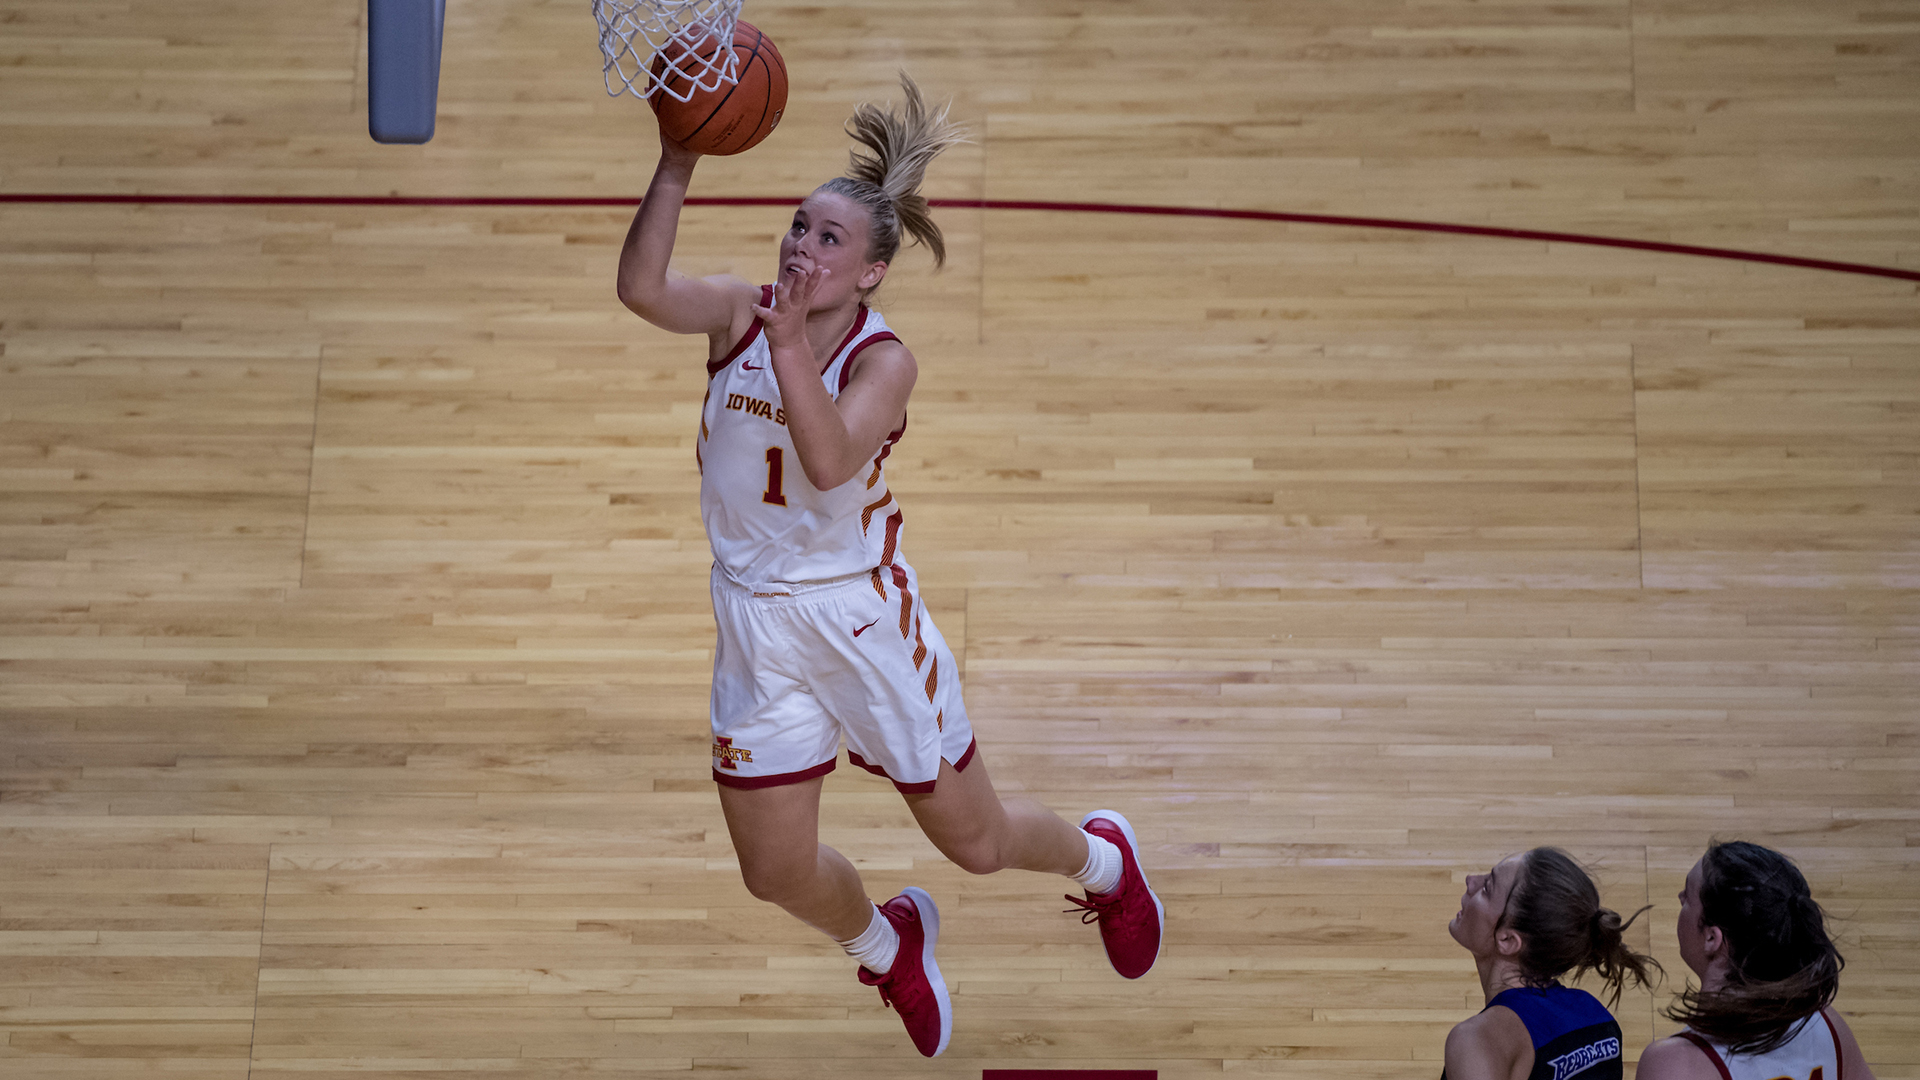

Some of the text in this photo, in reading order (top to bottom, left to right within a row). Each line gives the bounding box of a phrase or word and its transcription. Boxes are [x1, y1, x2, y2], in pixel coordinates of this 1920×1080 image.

[725, 392, 773, 420] IOWA
[762, 446, 788, 508] 1
[1548, 1037, 1620, 1080] BEARCATS
